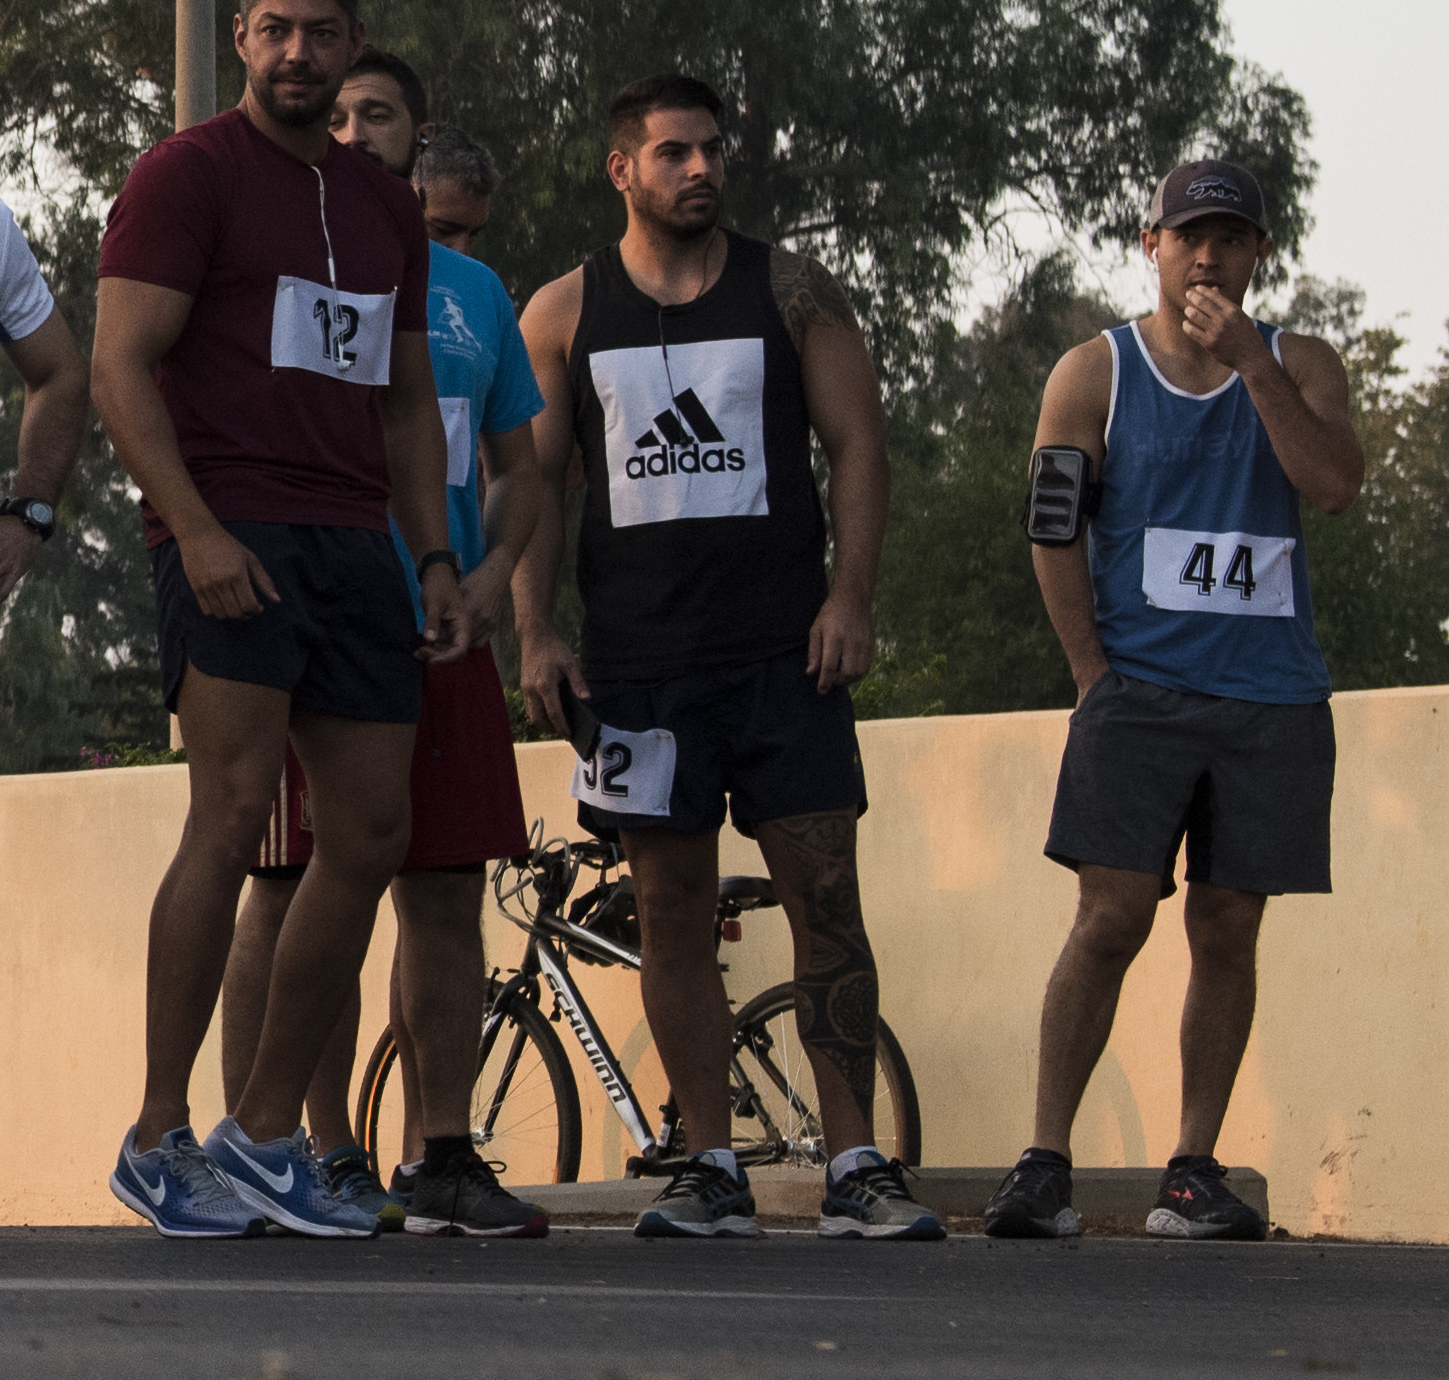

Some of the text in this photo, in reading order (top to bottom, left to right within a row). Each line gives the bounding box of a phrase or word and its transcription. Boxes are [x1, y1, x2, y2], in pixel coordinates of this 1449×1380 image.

[313, 297, 360, 368] 12
[625, 443, 746, 480] adidas
[1179, 542, 1257, 601] 44
